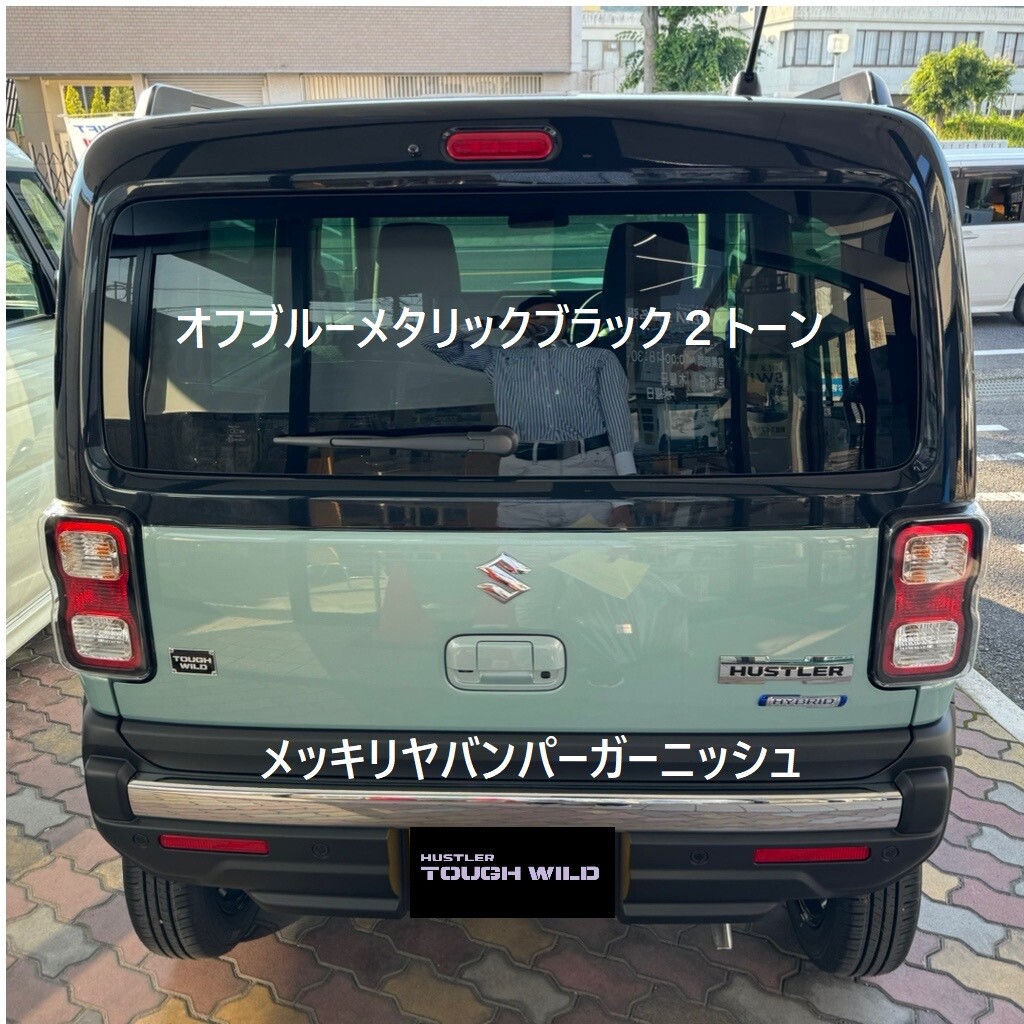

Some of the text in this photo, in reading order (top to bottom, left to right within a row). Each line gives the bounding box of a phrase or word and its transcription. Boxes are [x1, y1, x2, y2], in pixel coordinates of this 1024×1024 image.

[173, 656, 212, 664] TOUGH
[729, 666, 844, 677] HUSTLER
[771, 697, 835, 706] HYBRID
